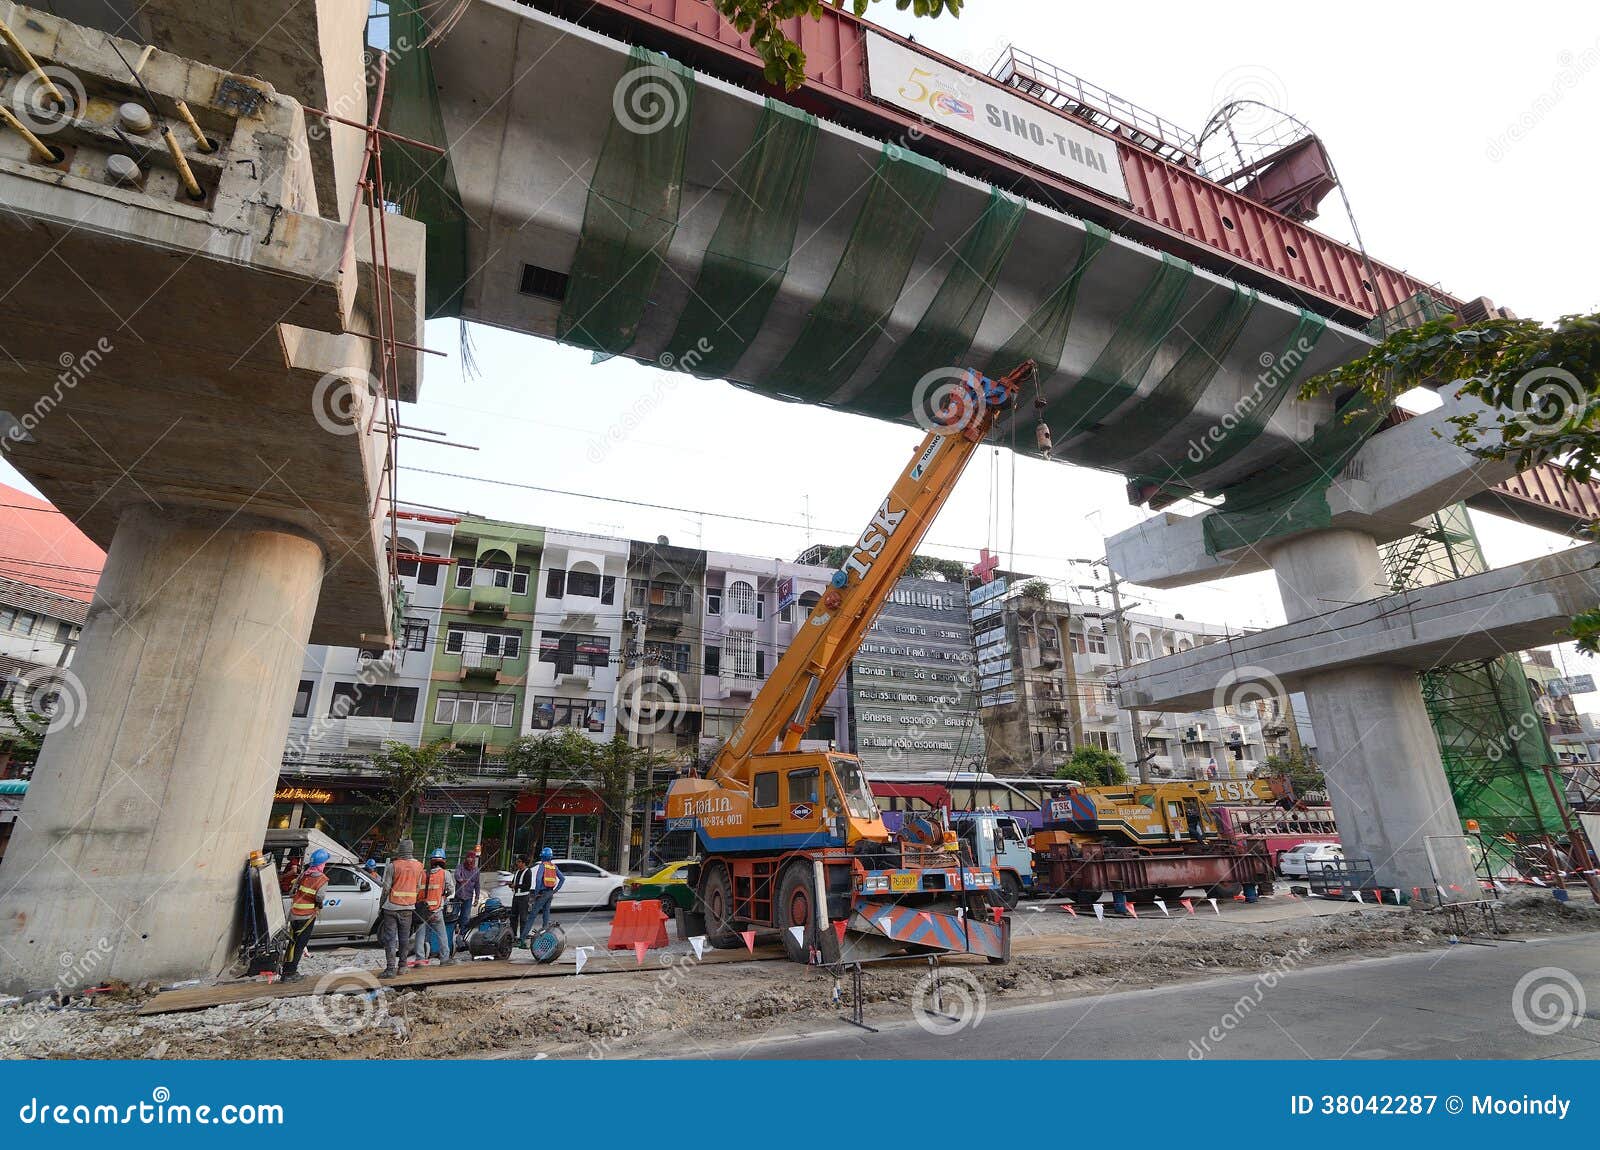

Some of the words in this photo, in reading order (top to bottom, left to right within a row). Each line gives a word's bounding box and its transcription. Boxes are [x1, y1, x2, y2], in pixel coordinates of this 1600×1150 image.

[985, 103, 1107, 174] SINO-THAI
[922, 434, 942, 461] TADANO
[841, 497, 907, 581] TSK
[294, 788, 332, 803] Building
[1210, 781, 1259, 801] TSK
[1052, 801, 1070, 811] TSK
